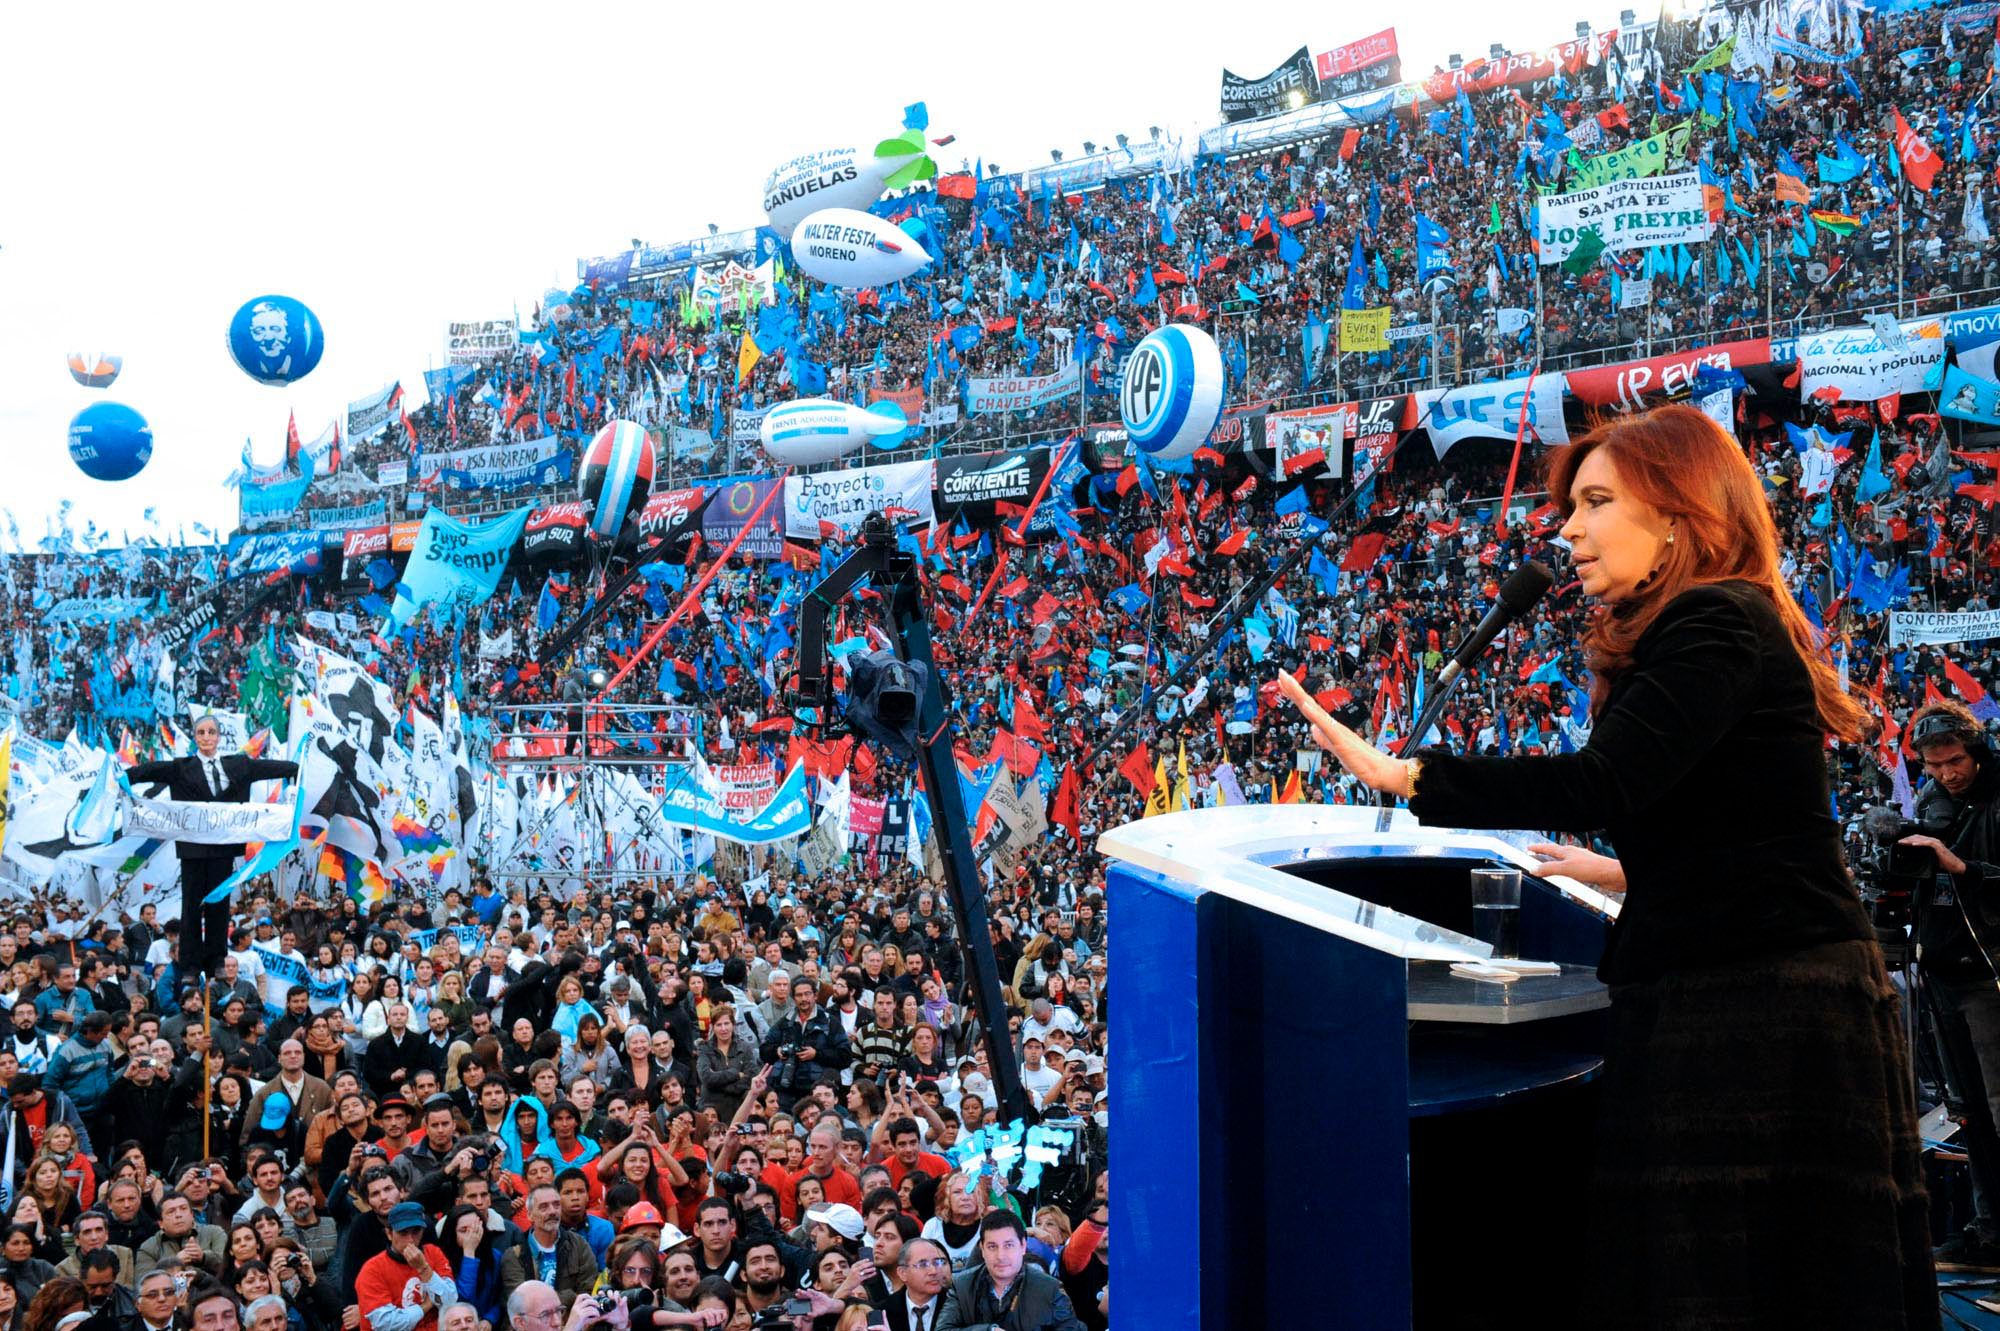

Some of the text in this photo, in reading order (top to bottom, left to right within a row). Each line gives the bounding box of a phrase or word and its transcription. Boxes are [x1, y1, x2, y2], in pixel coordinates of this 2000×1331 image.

[819, 158, 854, 174] MARISA
[1548, 176, 1698, 207] PARTIDO JUSTICIALISTA
[1579, 194, 1670, 219] SANTA FE
[803, 223, 876, 249] WALTER FESTA
[1634, 230, 1688, 242] General
[809, 245, 856, 262] MORENO
[1803, 364, 1866, 379] NACIONAL
[1870, 366, 1879, 376] Y
[1122, 349, 1162, 424] YPF
[1359, 399, 1395, 424] JP
[943, 467, 1030, 494] CORRIENTE
[813, 492, 904, 519] Comunidad
[430, 525, 469, 551] Tuyo
[548, 526, 575, 545] SUR
[704, 527, 730, 541] MESA
[1896, 613, 1925, 625] CON
[1927, 612, 1991, 626] CRISTINA
